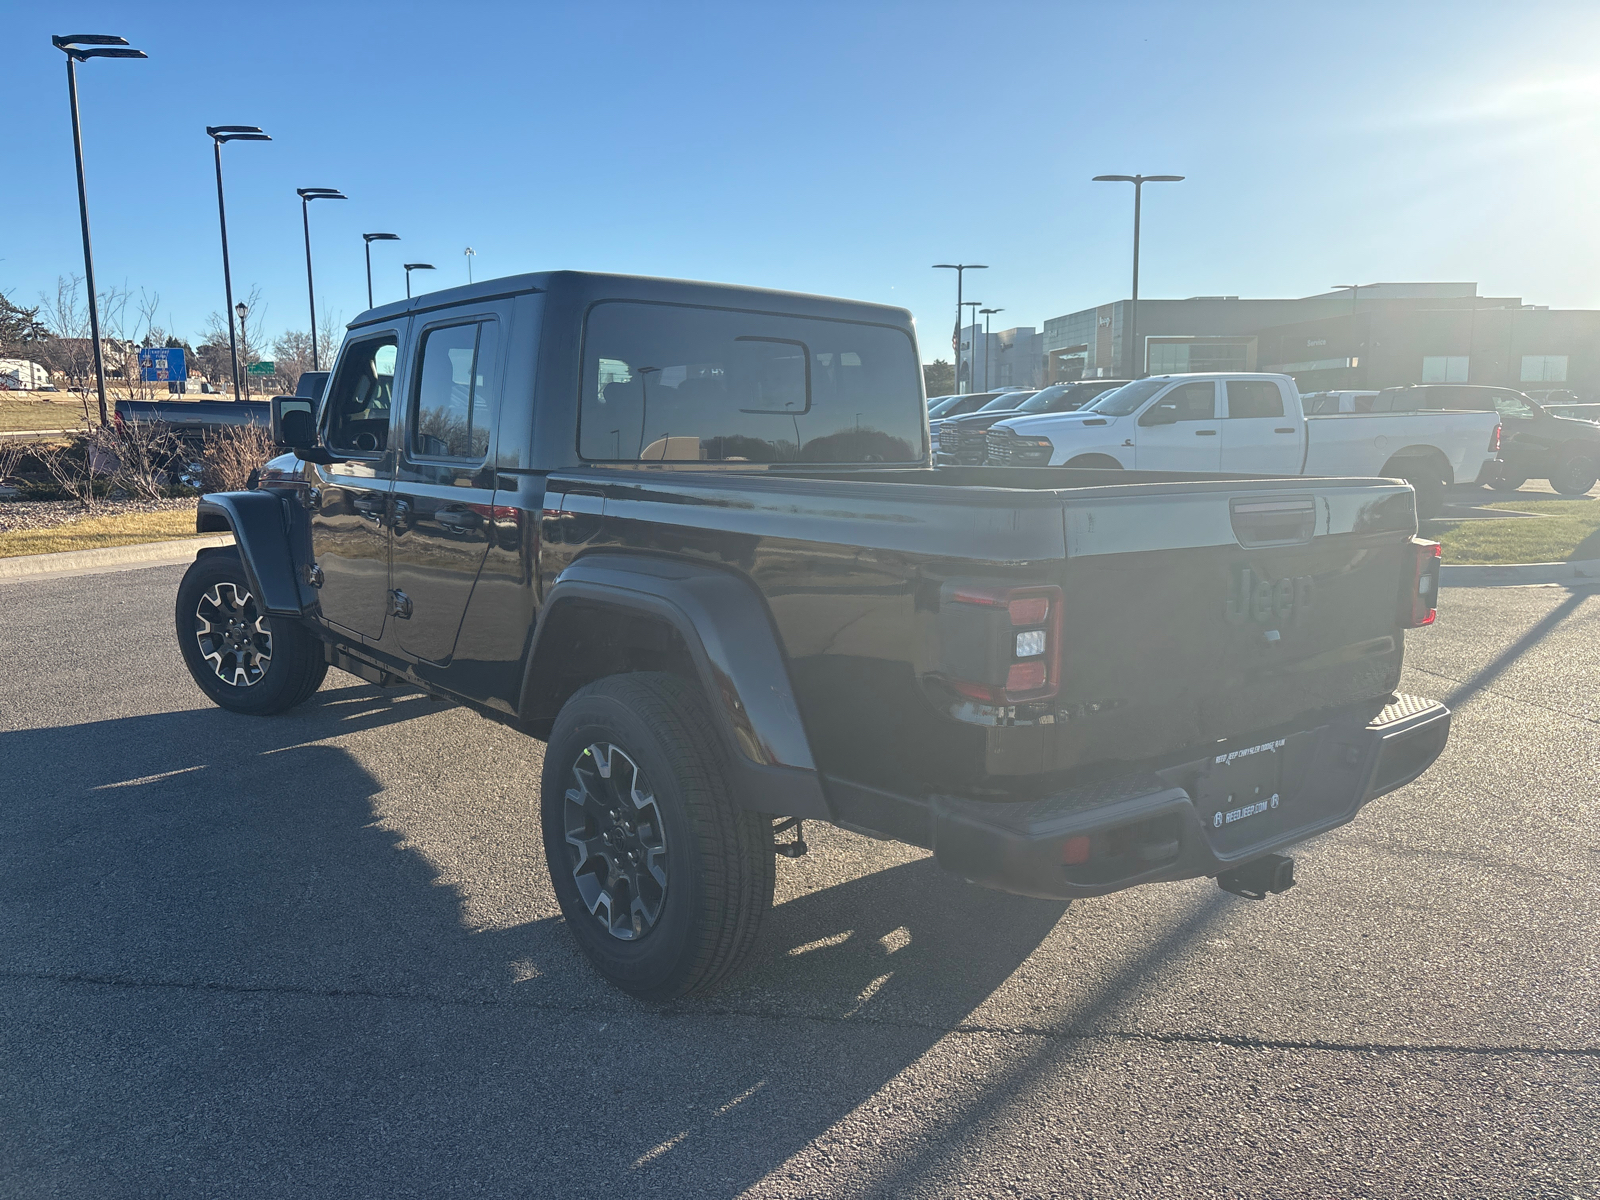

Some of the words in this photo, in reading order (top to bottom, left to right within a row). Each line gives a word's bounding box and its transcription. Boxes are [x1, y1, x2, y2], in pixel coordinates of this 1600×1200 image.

[1306, 338, 1327, 347] Service
[1225, 568, 1315, 626] Jeep
[1228, 751, 1238, 760] JEEP
[1238, 745, 1261, 758] CHRYSLER
[1225, 800, 1268, 824] REEDJEEP.COM
